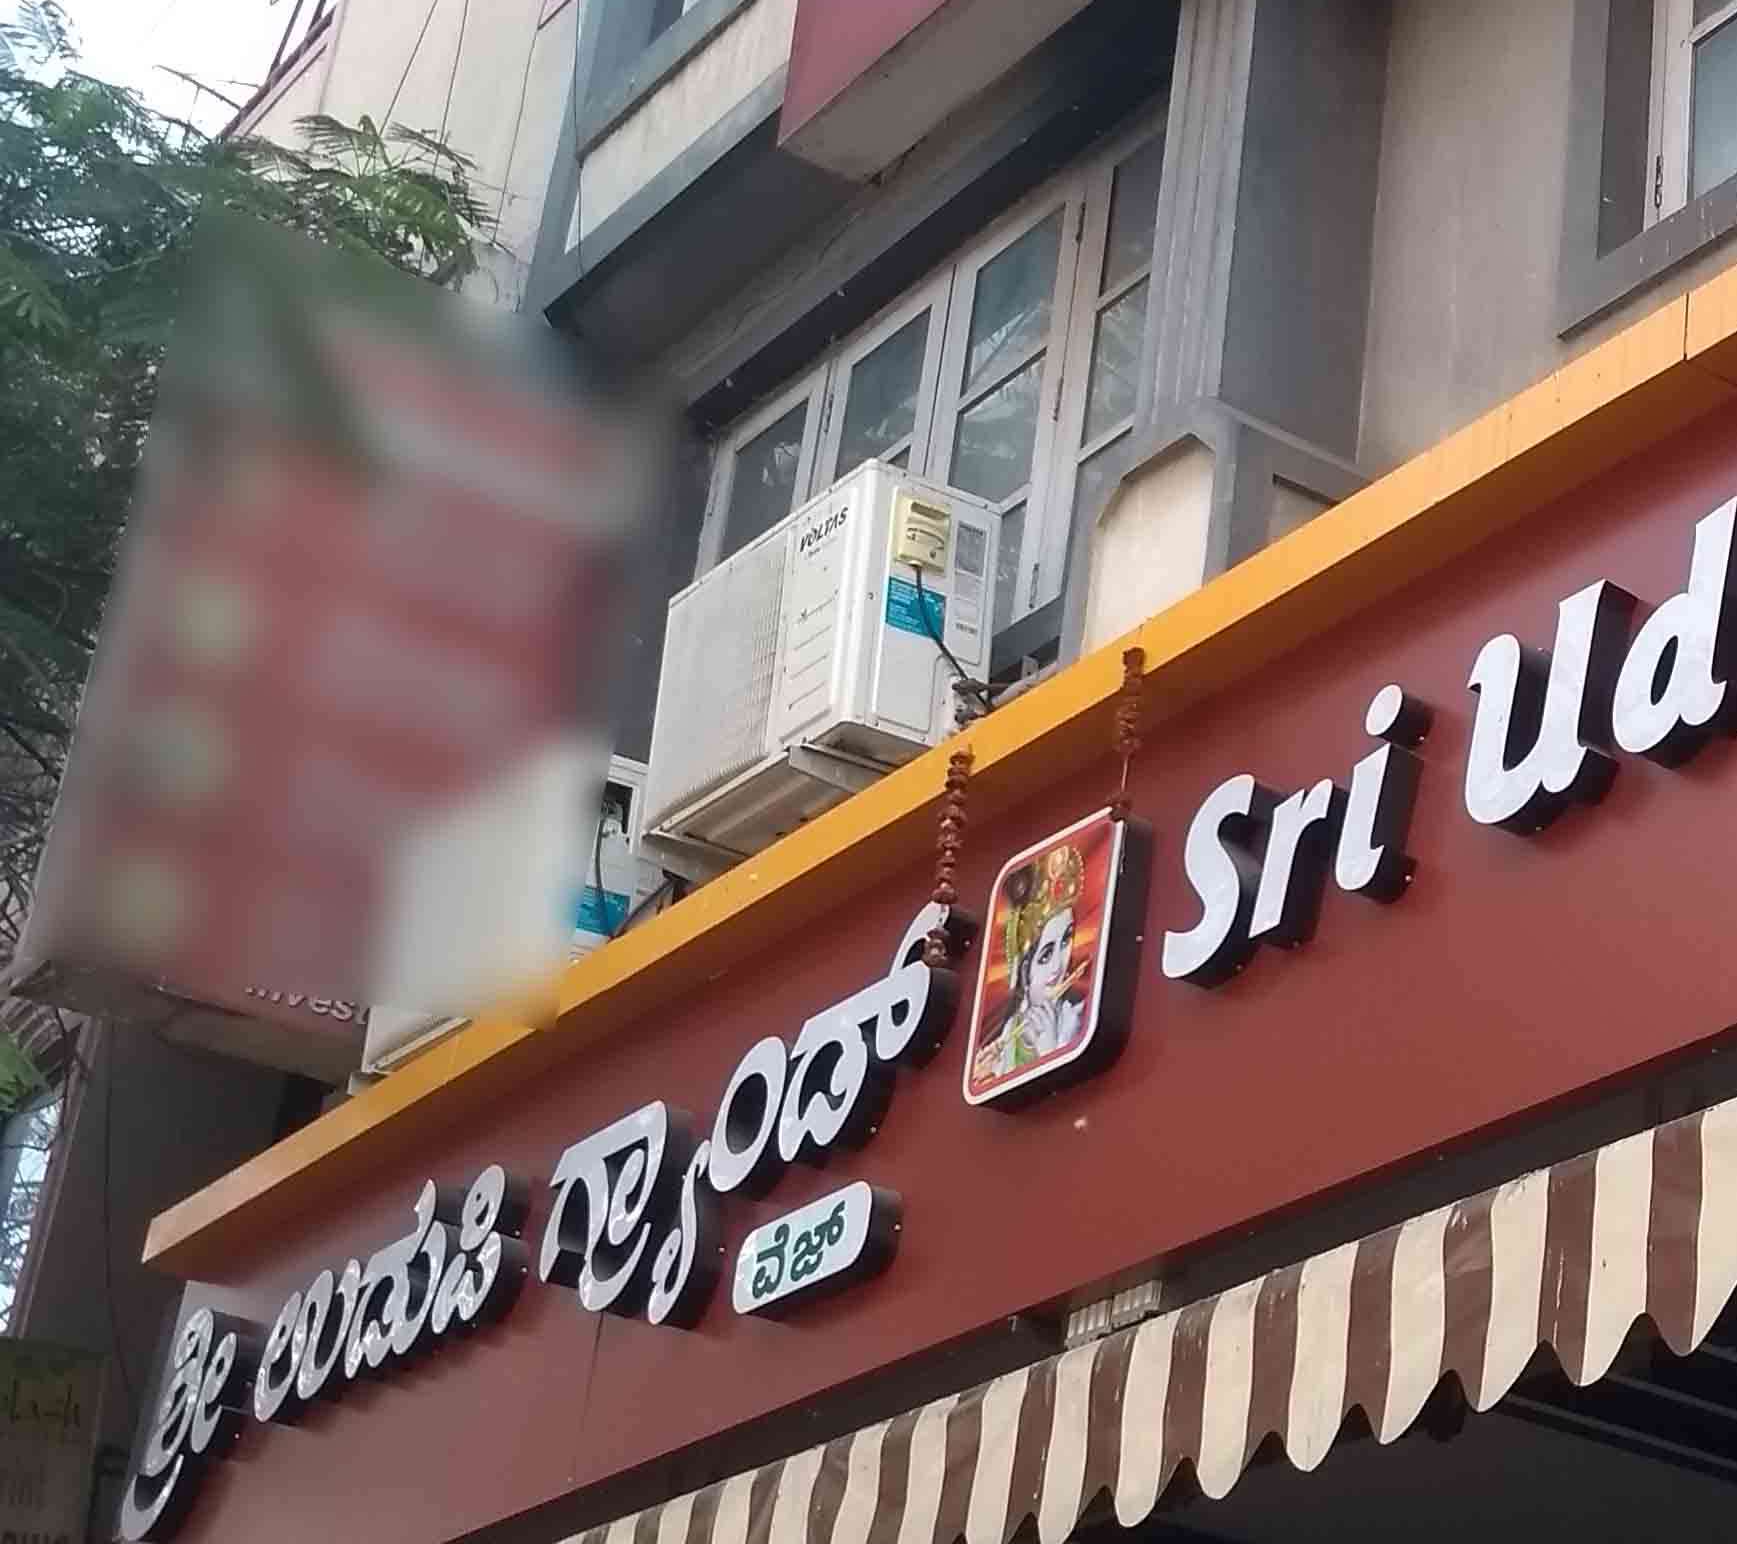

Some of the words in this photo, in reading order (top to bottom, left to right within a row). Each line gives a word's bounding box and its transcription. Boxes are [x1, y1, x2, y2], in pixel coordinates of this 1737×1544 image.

[800, 506, 849, 553] VOLTAS
[1162, 684, 1404, 981] Sri
[752, 1199, 846, 1300] ವೆಜ್
[121, 1306, 237, 1542] ಶ್ರೀ
[254, 1164, 506, 1413] ಉಡುಪಿ
